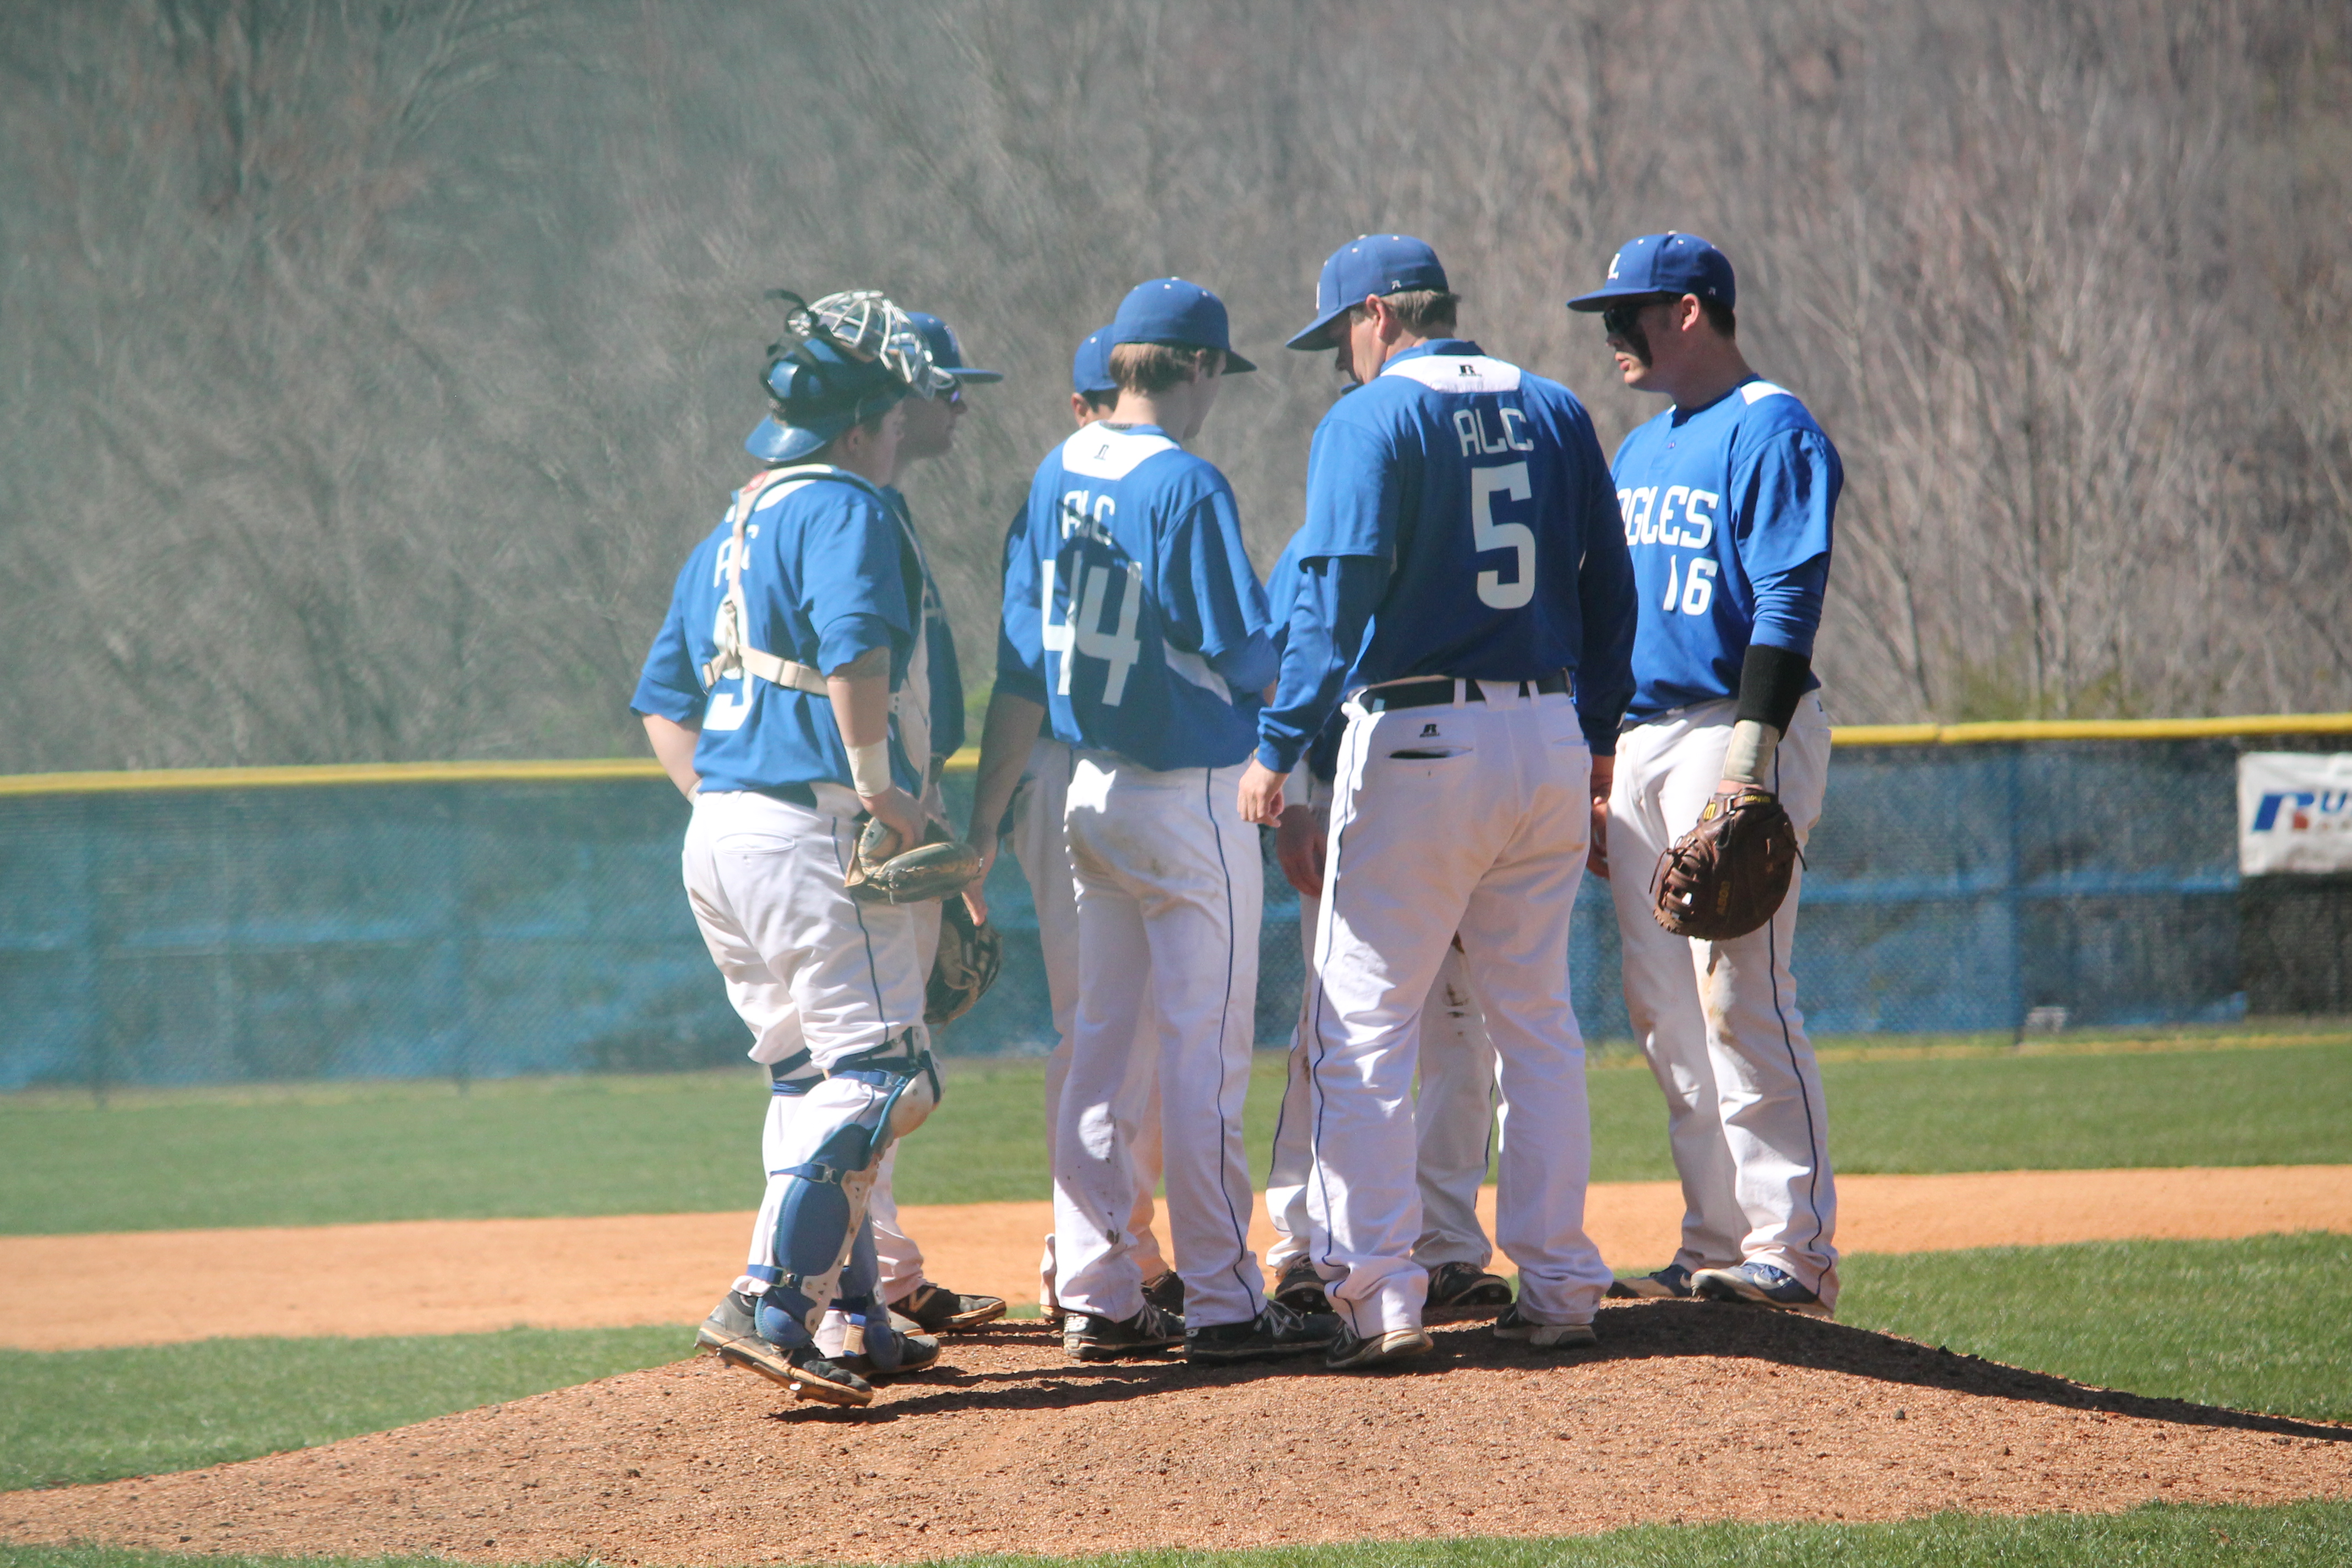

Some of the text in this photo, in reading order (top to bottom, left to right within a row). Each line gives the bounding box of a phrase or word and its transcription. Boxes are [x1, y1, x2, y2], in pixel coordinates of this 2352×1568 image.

[1453, 408, 1534, 458] ALC
[1061, 489, 1116, 546] ALC
[1471, 461, 1536, 610] 5
[1663, 554, 1719, 616] 16
[1042, 551, 1142, 707] 44
